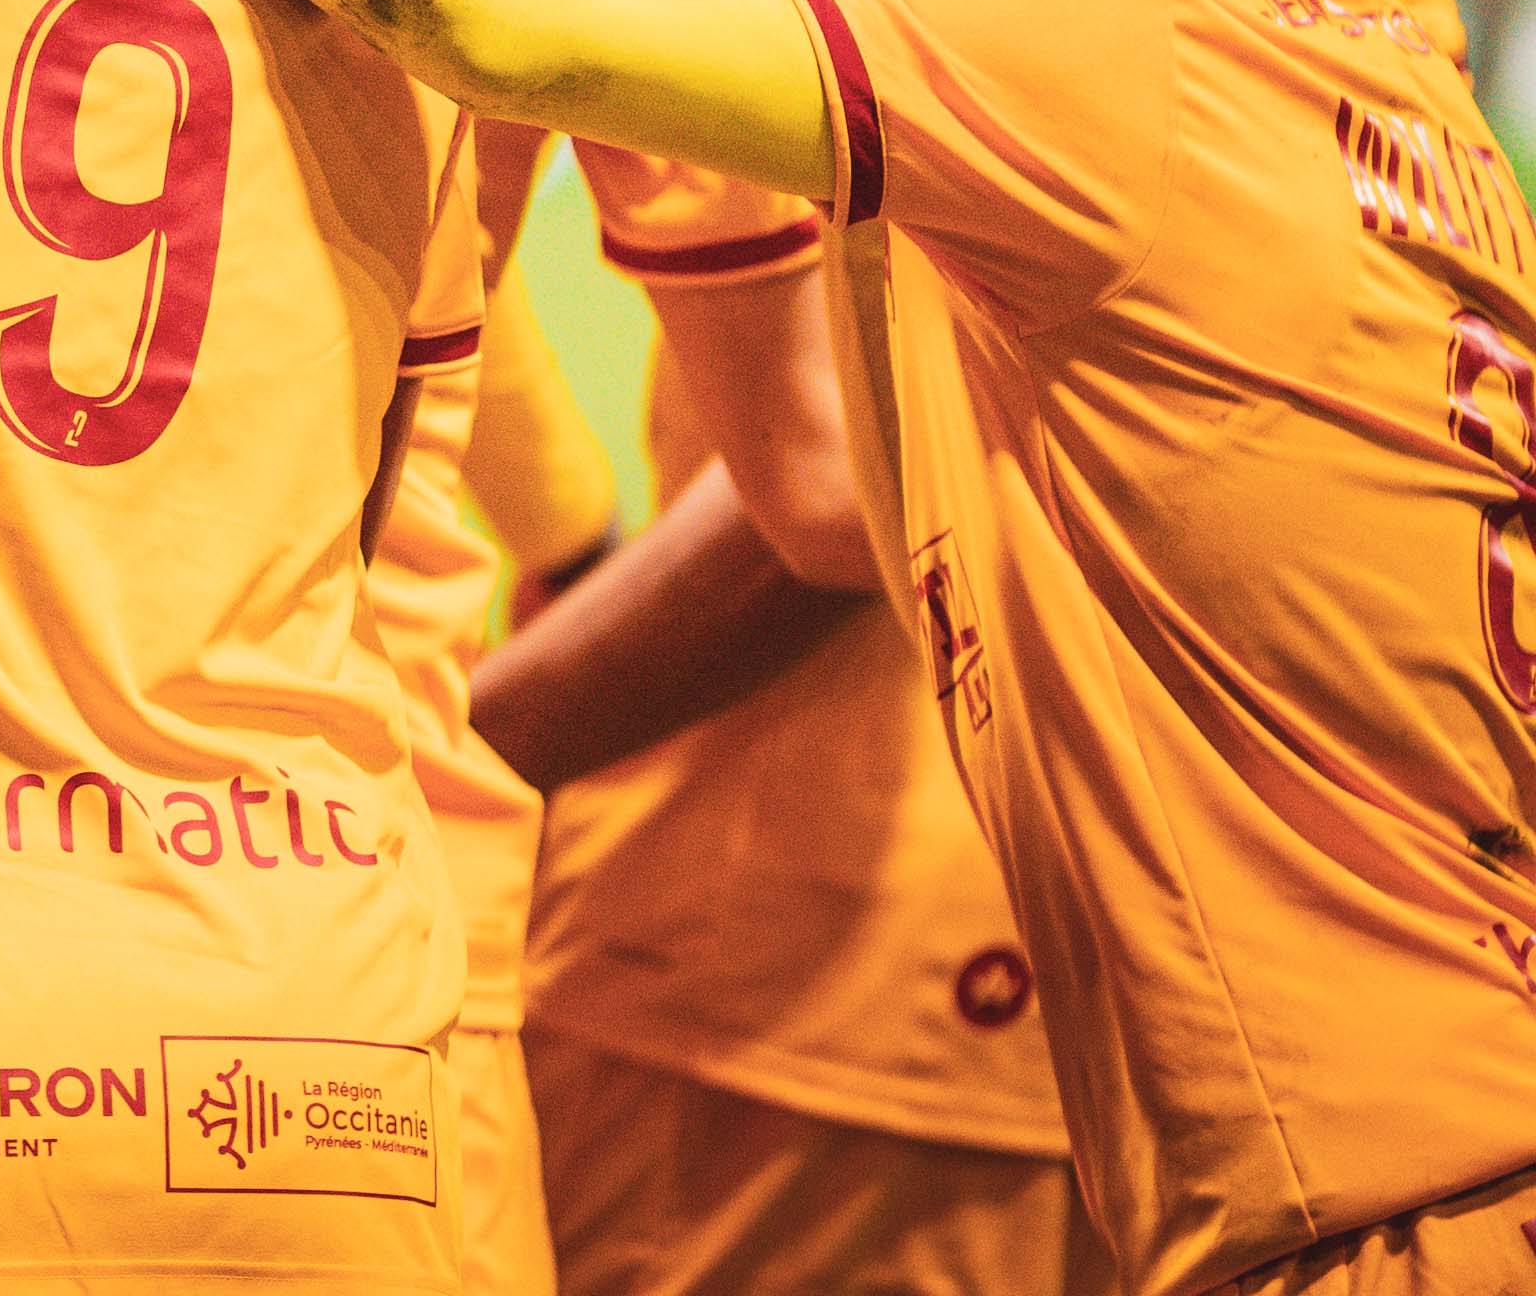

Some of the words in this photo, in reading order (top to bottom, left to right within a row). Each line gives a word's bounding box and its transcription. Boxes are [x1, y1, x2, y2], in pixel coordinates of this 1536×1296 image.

[302, 1080, 322, 1096] La
[328, 1080, 382, 1102] Région
[305, 1102, 428, 1140] Occitanie
